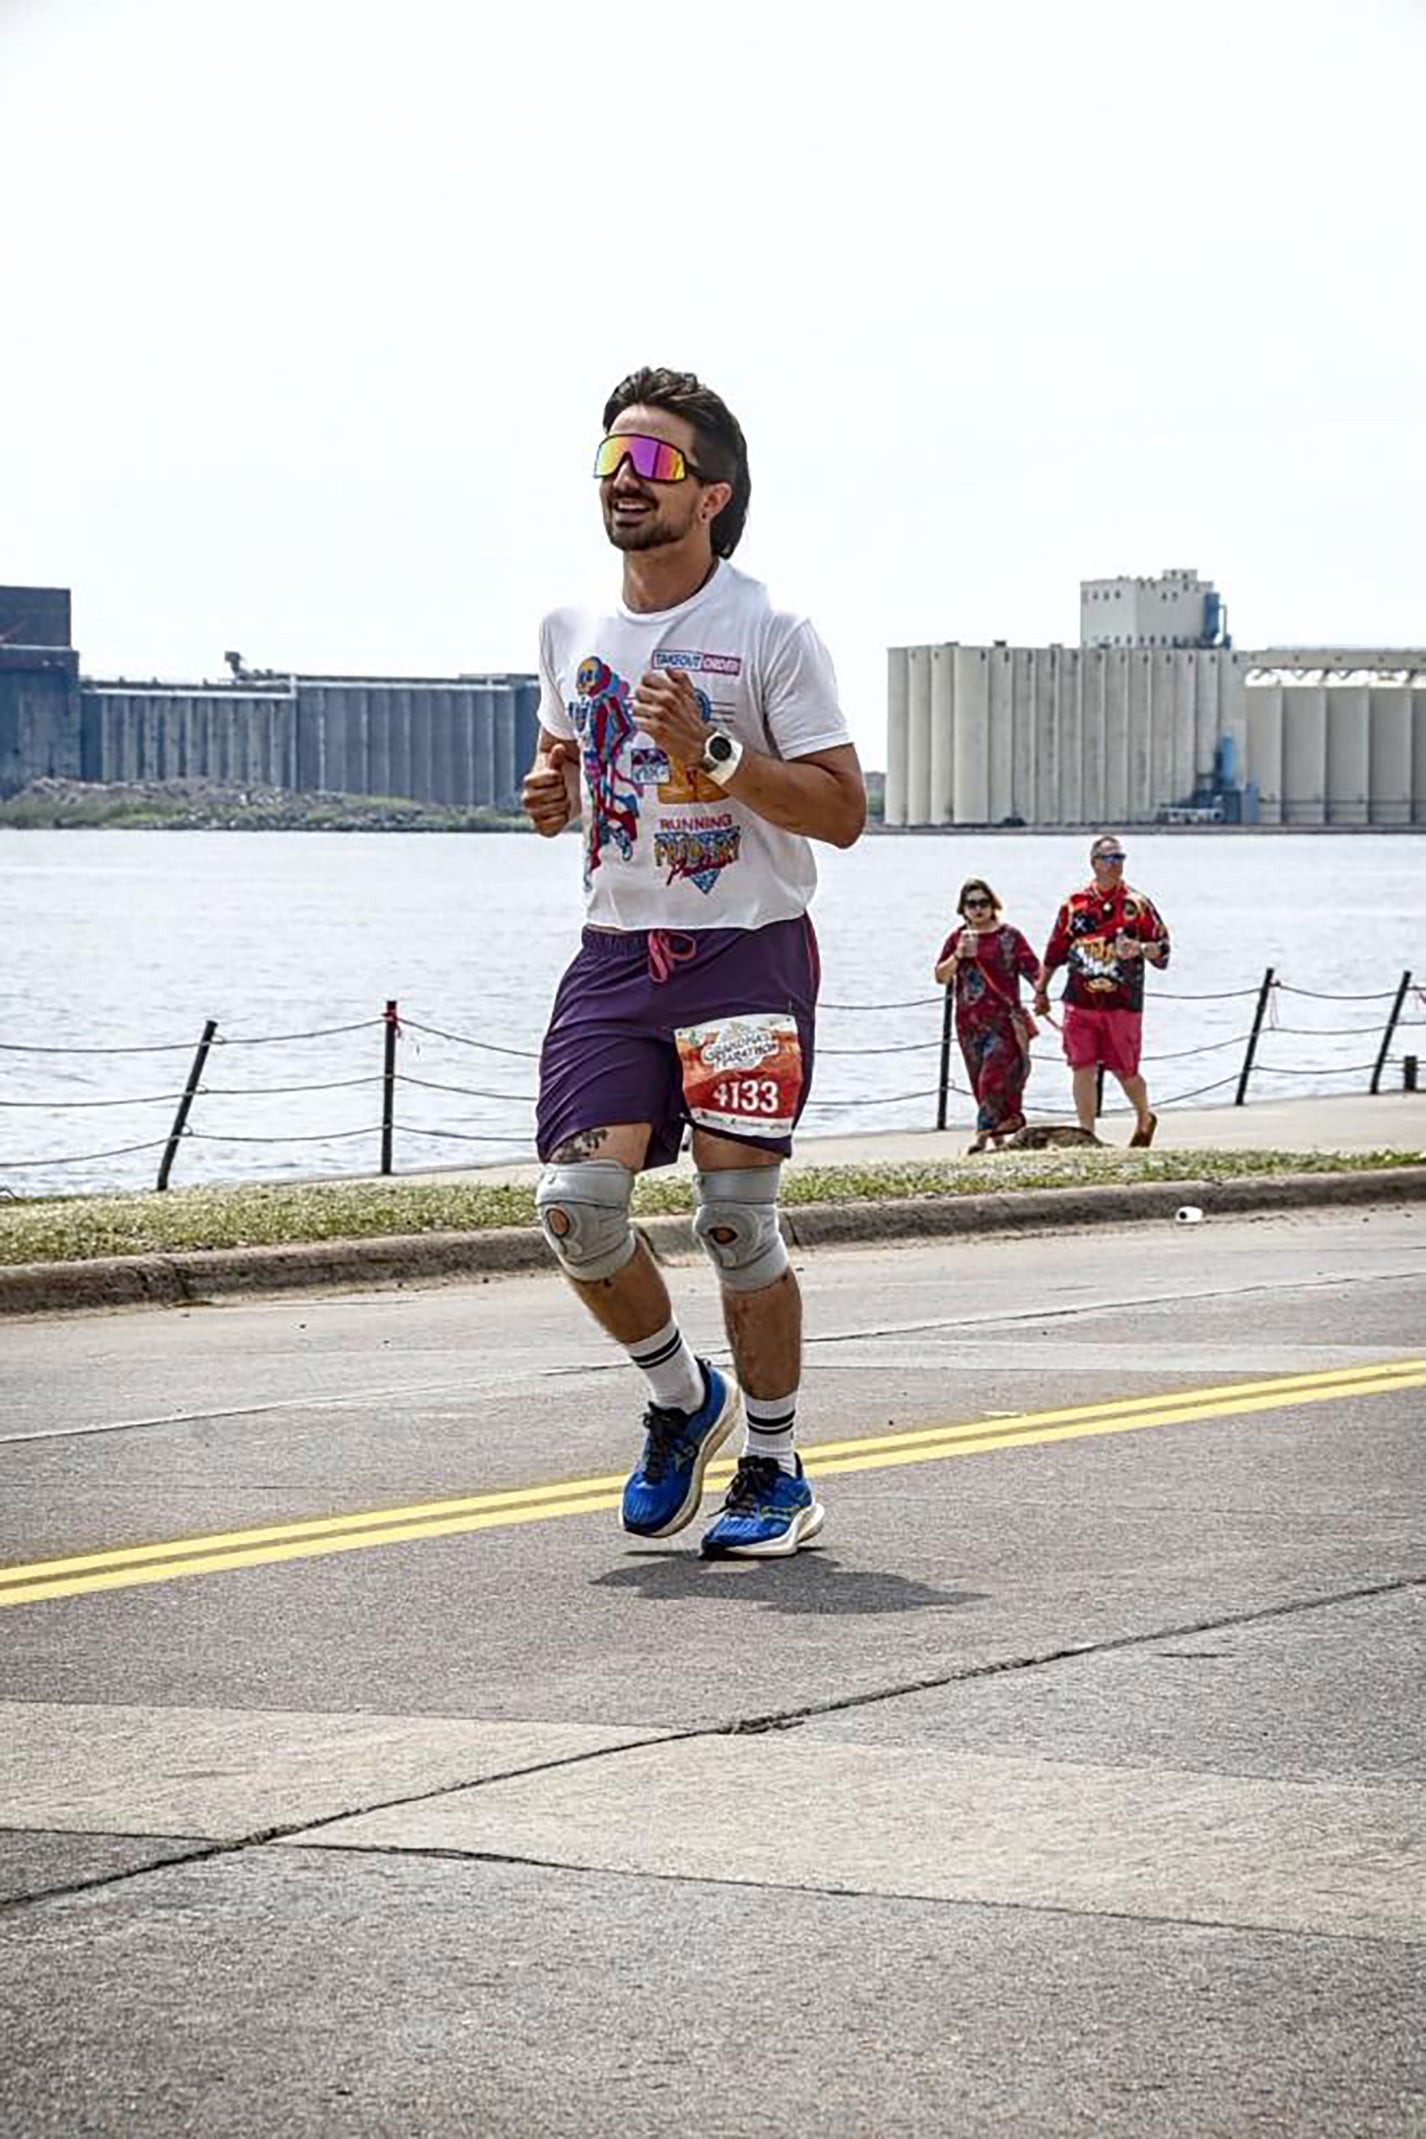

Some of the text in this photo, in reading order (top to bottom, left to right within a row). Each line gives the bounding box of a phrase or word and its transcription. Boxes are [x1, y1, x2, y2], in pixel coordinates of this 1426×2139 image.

[656, 653, 739, 673] TAKEOUT ORDER
[659, 813, 733, 830] RUNNING
[713, 1079, 779, 1113] 4133
